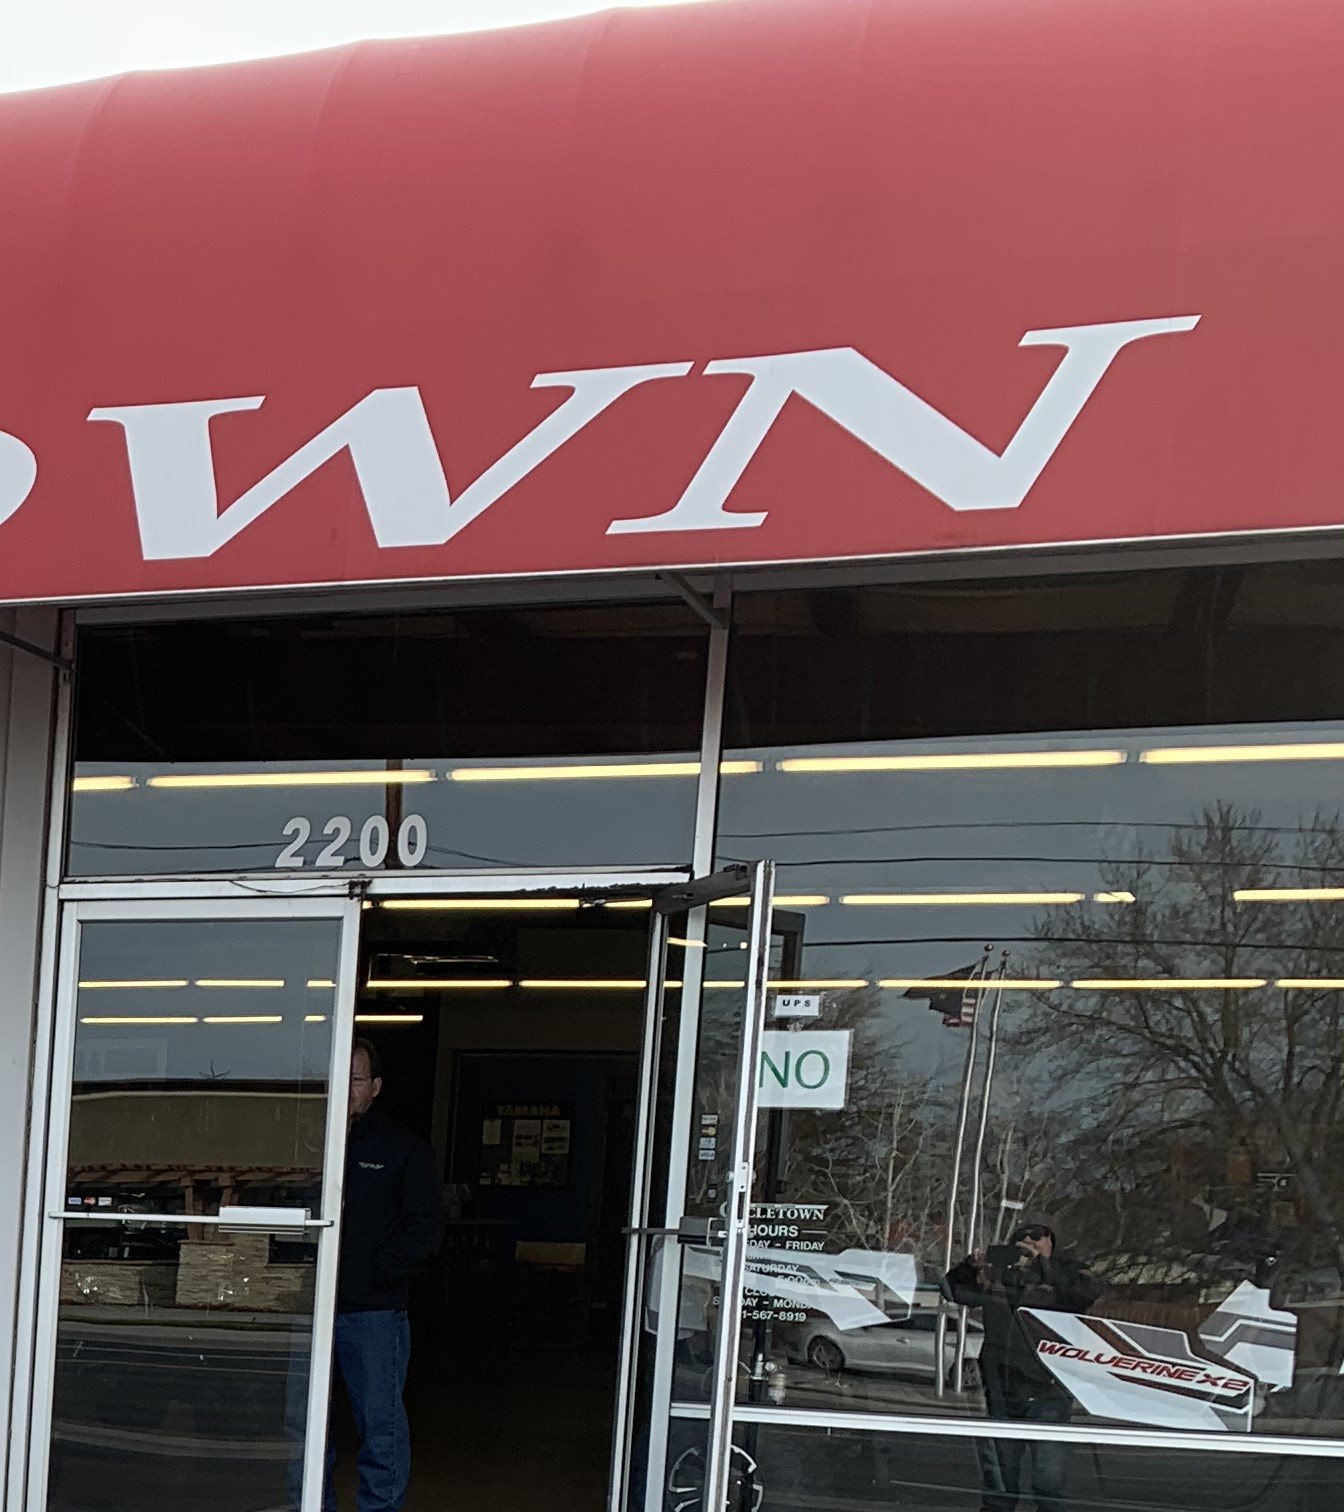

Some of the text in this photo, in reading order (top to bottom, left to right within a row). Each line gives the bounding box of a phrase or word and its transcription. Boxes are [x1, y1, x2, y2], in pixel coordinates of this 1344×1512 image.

[274, 813, 428, 869] 2200
[781, 999, 813, 1009] UPS
[758, 1049, 831, 1090] NO
[495, 1104, 561, 1117] YAMAHA
[748, 1224, 799, 1238] HOURS
[785, 1240, 825, 1251] FRIDAY
[1038, 1340, 1252, 1392] WOLVERINE X2
